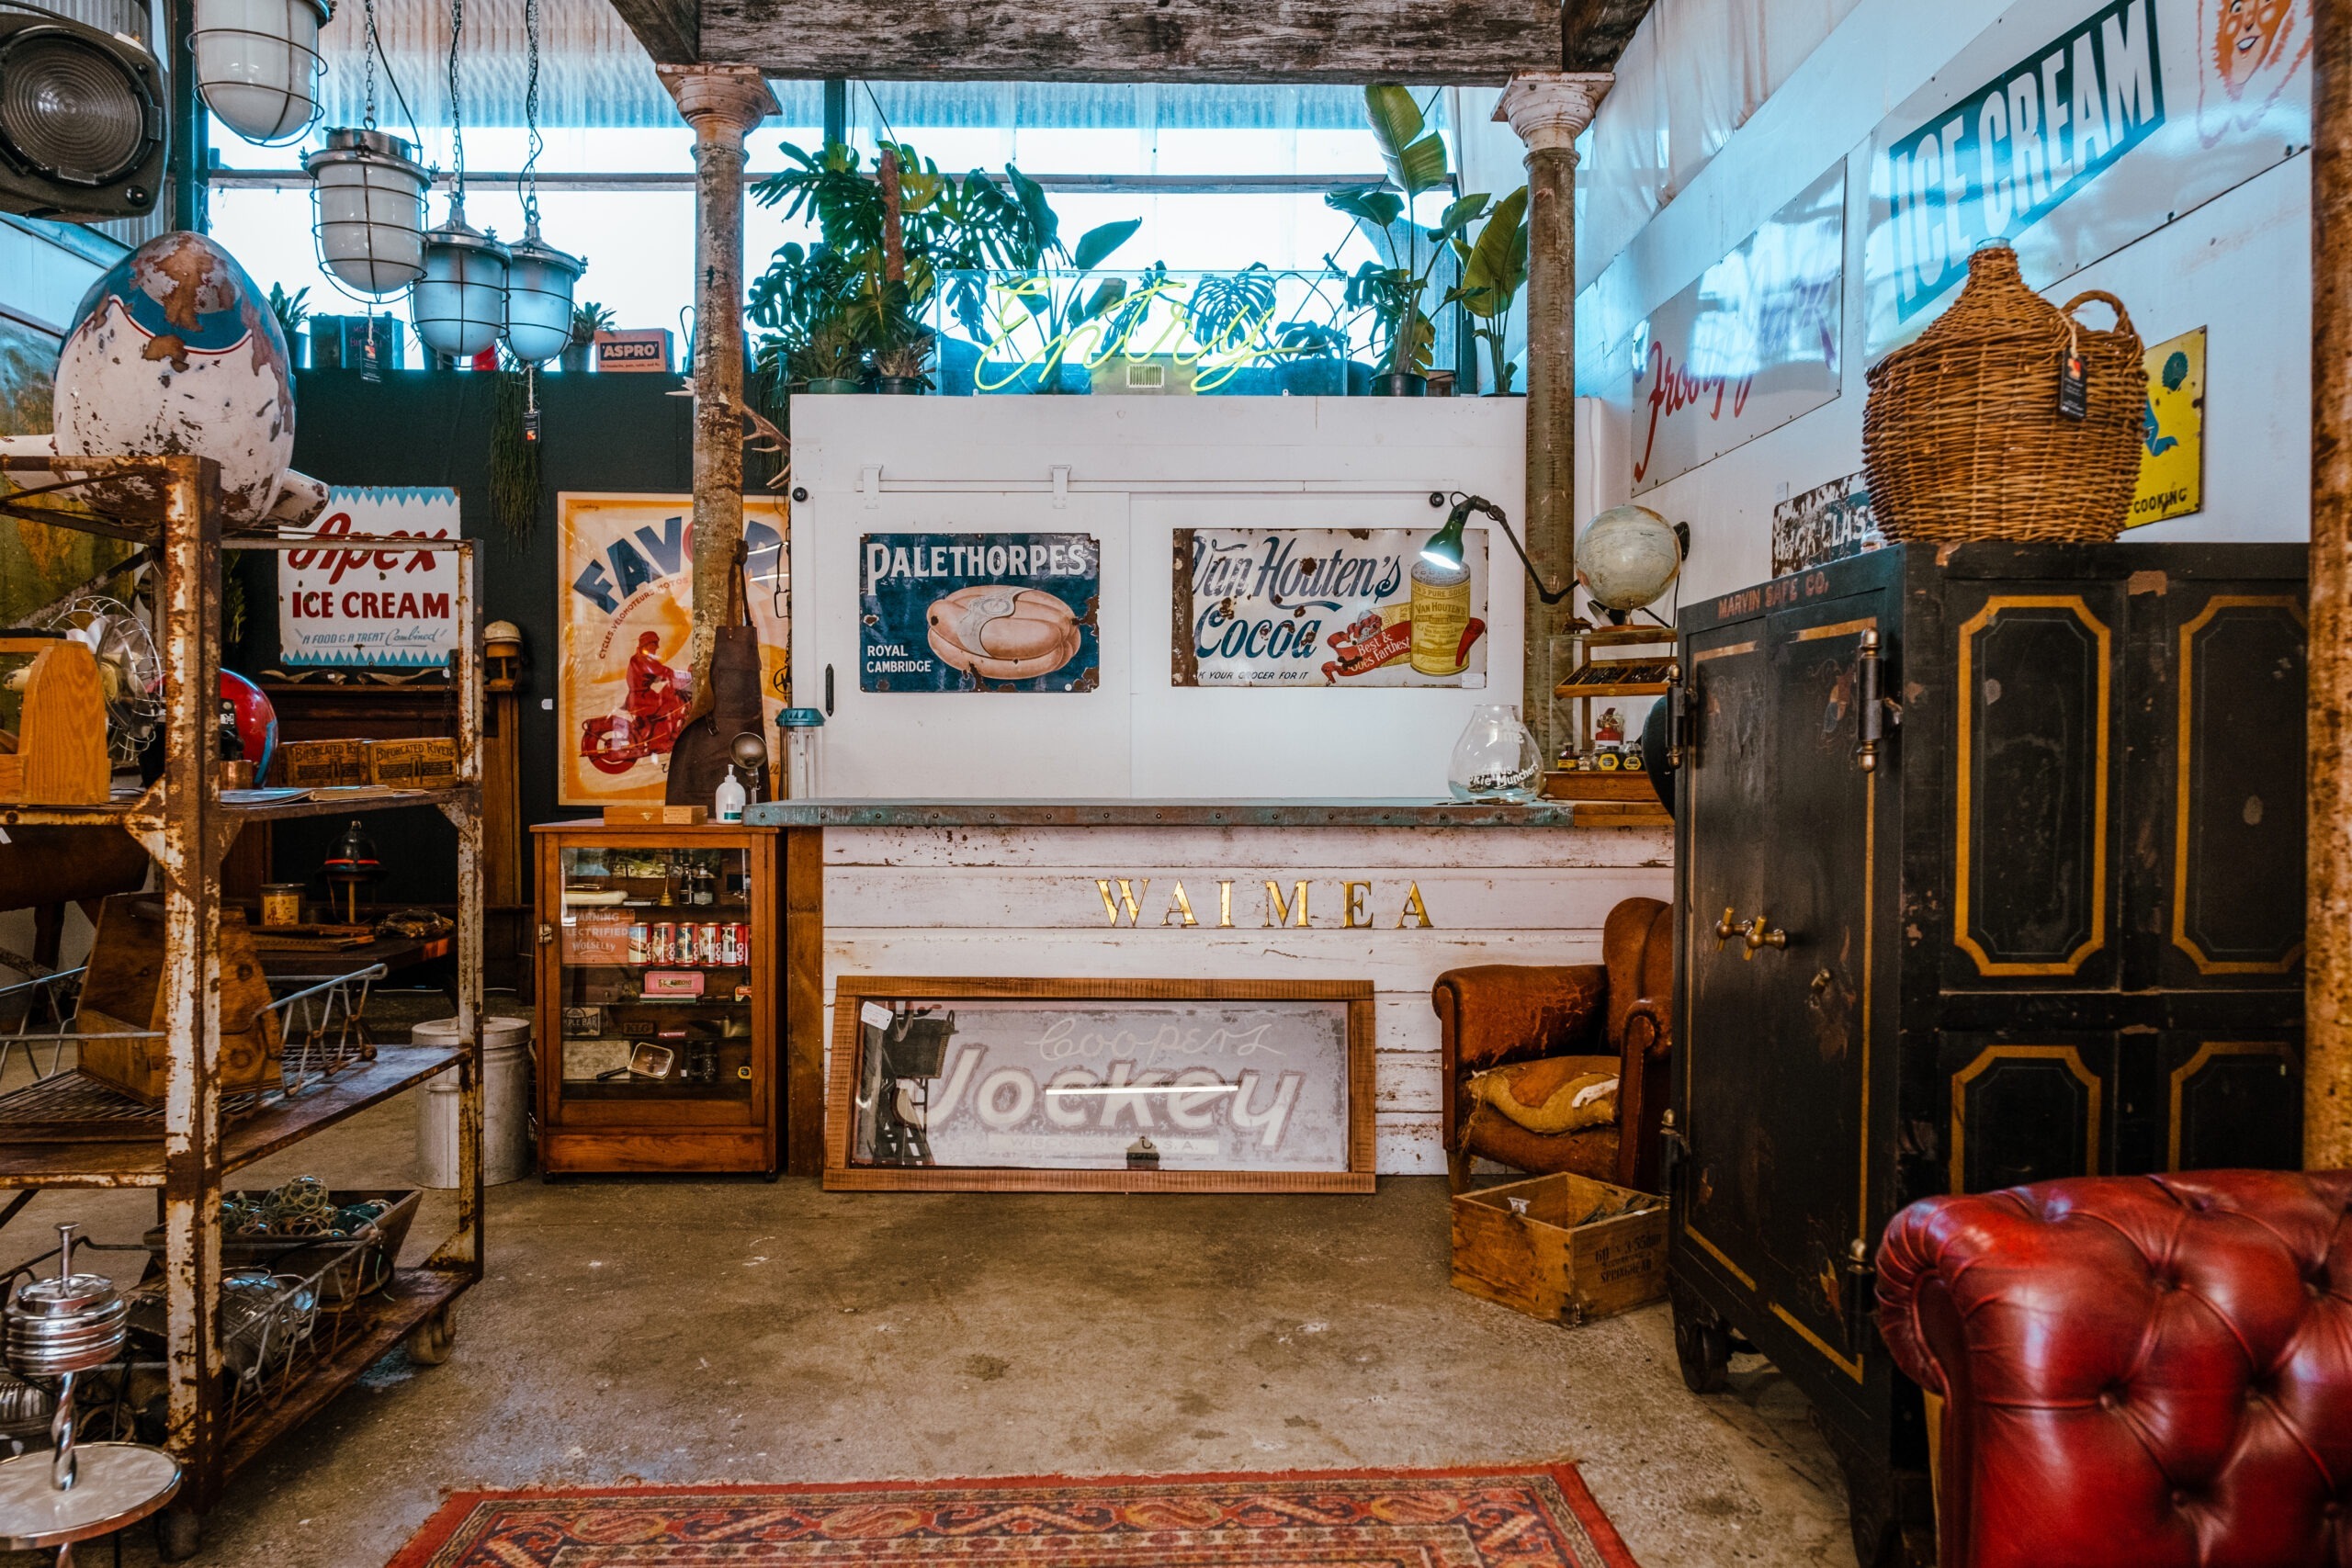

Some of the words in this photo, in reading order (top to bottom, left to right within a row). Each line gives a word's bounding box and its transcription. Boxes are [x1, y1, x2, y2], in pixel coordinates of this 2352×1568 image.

[1896, 114, 1971, 305] ICE
[1978, 0, 2155, 238] CREAM
[975, 276, 1307, 391] Entry
[2133, 488, 2188, 513] COOKING
[288, 512, 448, 585] Apex
[572, 516, 783, 615] FAVR
[866, 543, 1087, 596] PALETHORPES
[1193, 535, 1251, 597] Van
[1253, 536, 1401, 613] Houten's
[292, 592, 334, 618] ICE
[341, 592, 450, 619] CREAM
[1416, 603, 1430, 615] VAN
[1718, 589, 1761, 620] MARVIN
[1765, 578, 1798, 608] SAFE
[302, 636, 311, 645] A
[311, 635, 337, 644] FOOD
[338, 634, 346, 643] &
[347, 633, 355, 642] A
[356, 631, 385, 642] TREAT
[385, 626, 436, 646] Combined
[1196, 602, 1322, 660] Cocoa
[1357, 637, 1382, 657] Best
[1382, 631, 1394, 643] &
[1373, 635, 1411, 661] Farthest
[866, 645, 909, 658] ROYAL
[866, 660, 932, 673] CAMBRIDGE
[1208, 671, 1233, 680] YOUR
[1278, 671, 1296, 680] FOR
[1298, 671, 1308, 680] IT
[376, 745, 424, 761] BIFURCATED
[427, 742, 455, 757] RIVETS
[1096, 878, 1434, 929] WAIMEA
[893, 1043, 1307, 1152] Jockey
